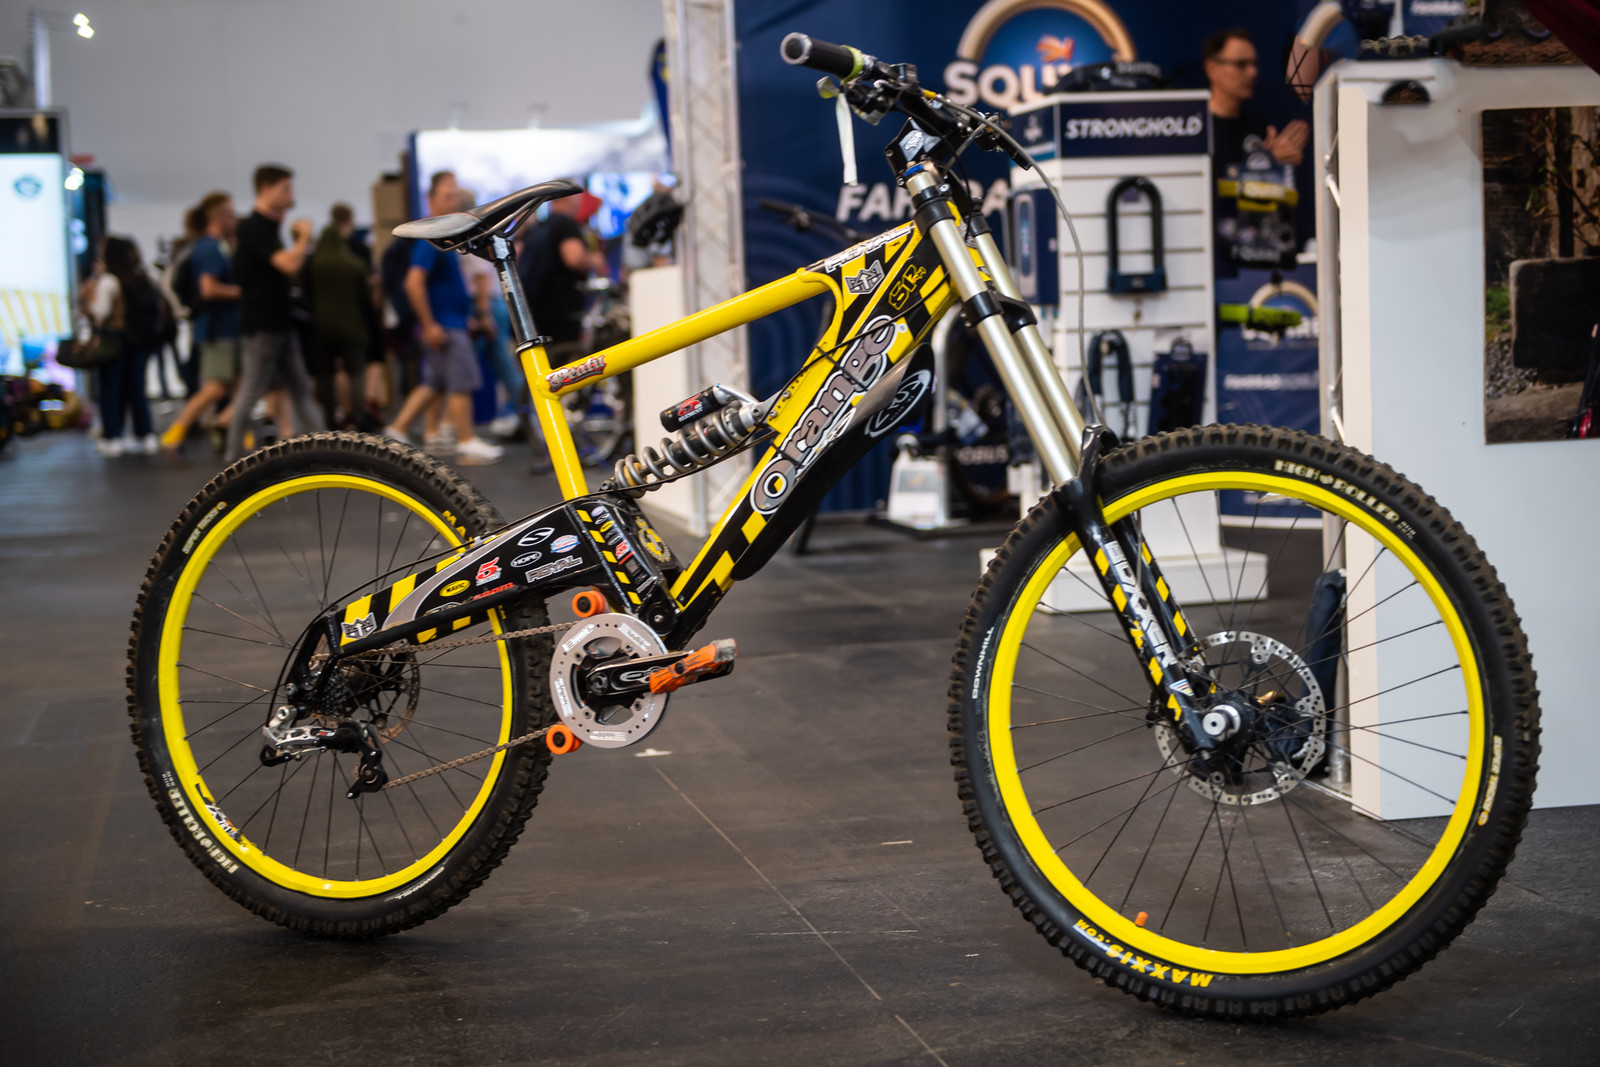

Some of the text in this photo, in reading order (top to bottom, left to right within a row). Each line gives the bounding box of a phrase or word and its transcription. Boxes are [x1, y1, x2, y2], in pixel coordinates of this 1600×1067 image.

[1065, 115, 1202, 140] STRONGHOLD
[1274, 459, 1400, 523] HIGH ROLLER
[513, 552, 539, 567] HOPE
[525, 555, 584, 584] ROYAL
[971, 626, 995, 699] DOWNHILL
[168, 786, 207, 841] ROLLER
[206, 844, 240, 874] HIGH
